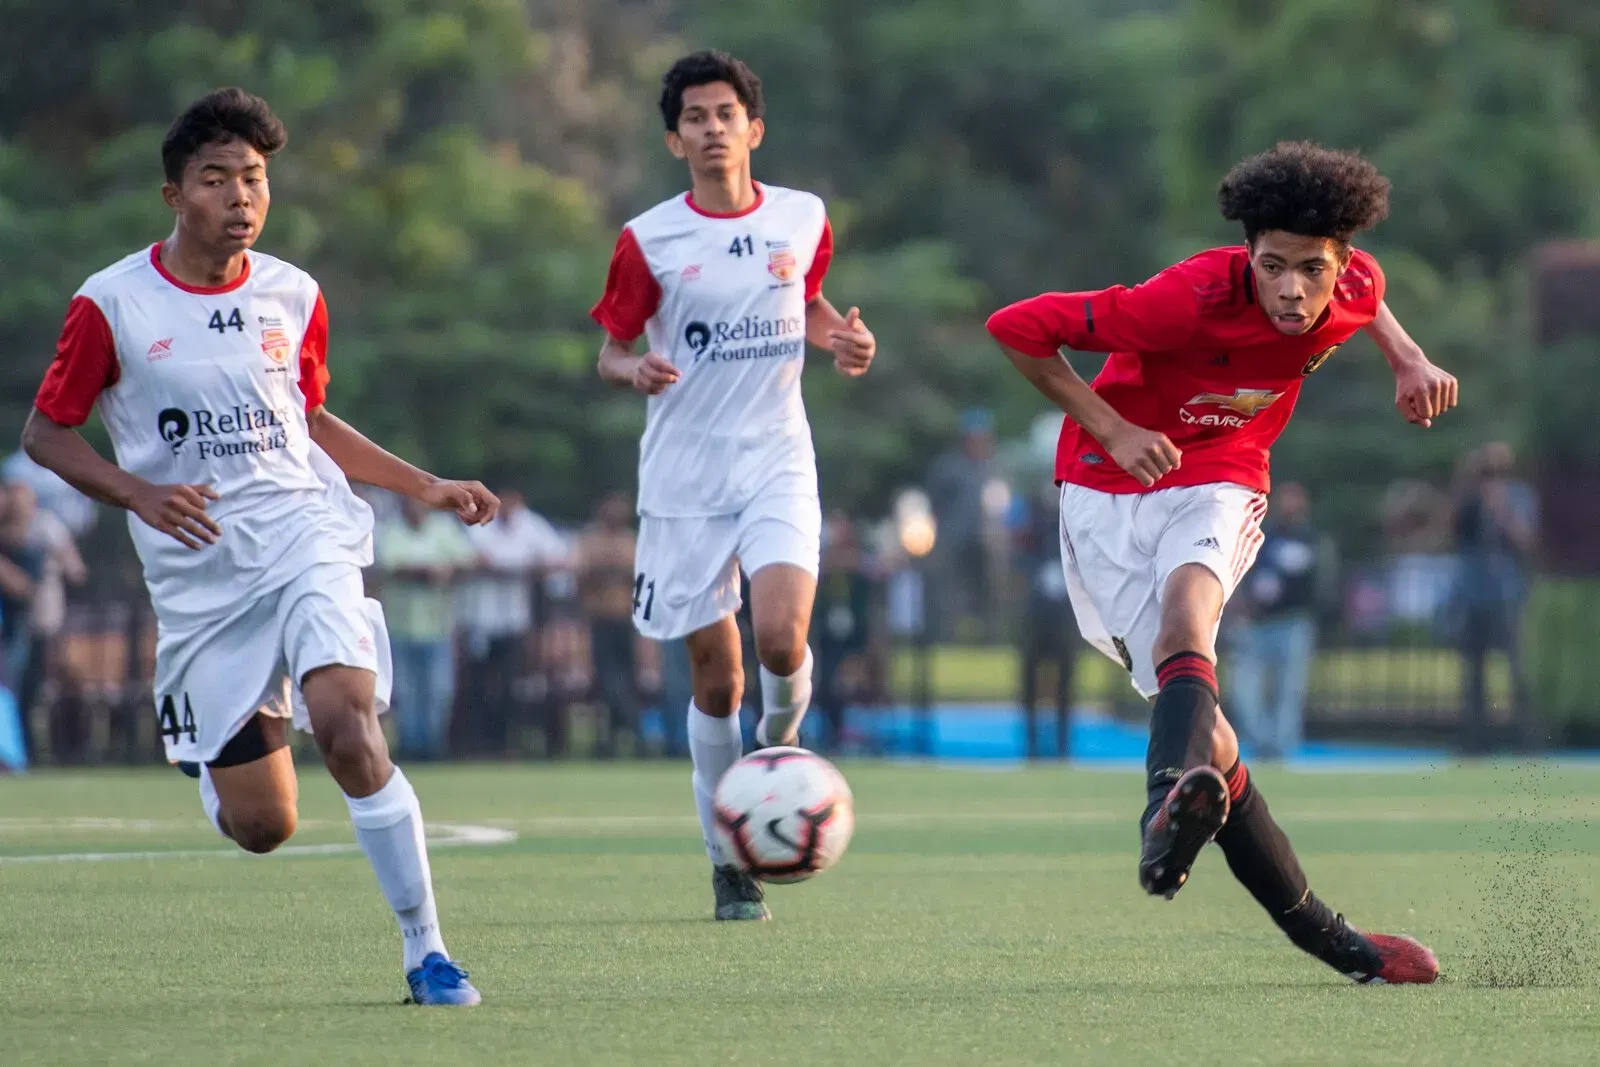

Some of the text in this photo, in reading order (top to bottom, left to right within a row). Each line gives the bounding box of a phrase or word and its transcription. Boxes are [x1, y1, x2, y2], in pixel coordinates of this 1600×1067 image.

[728, 234, 755, 258] 41
[208, 308, 245, 334] 44
[160, 691, 198, 745] 44
